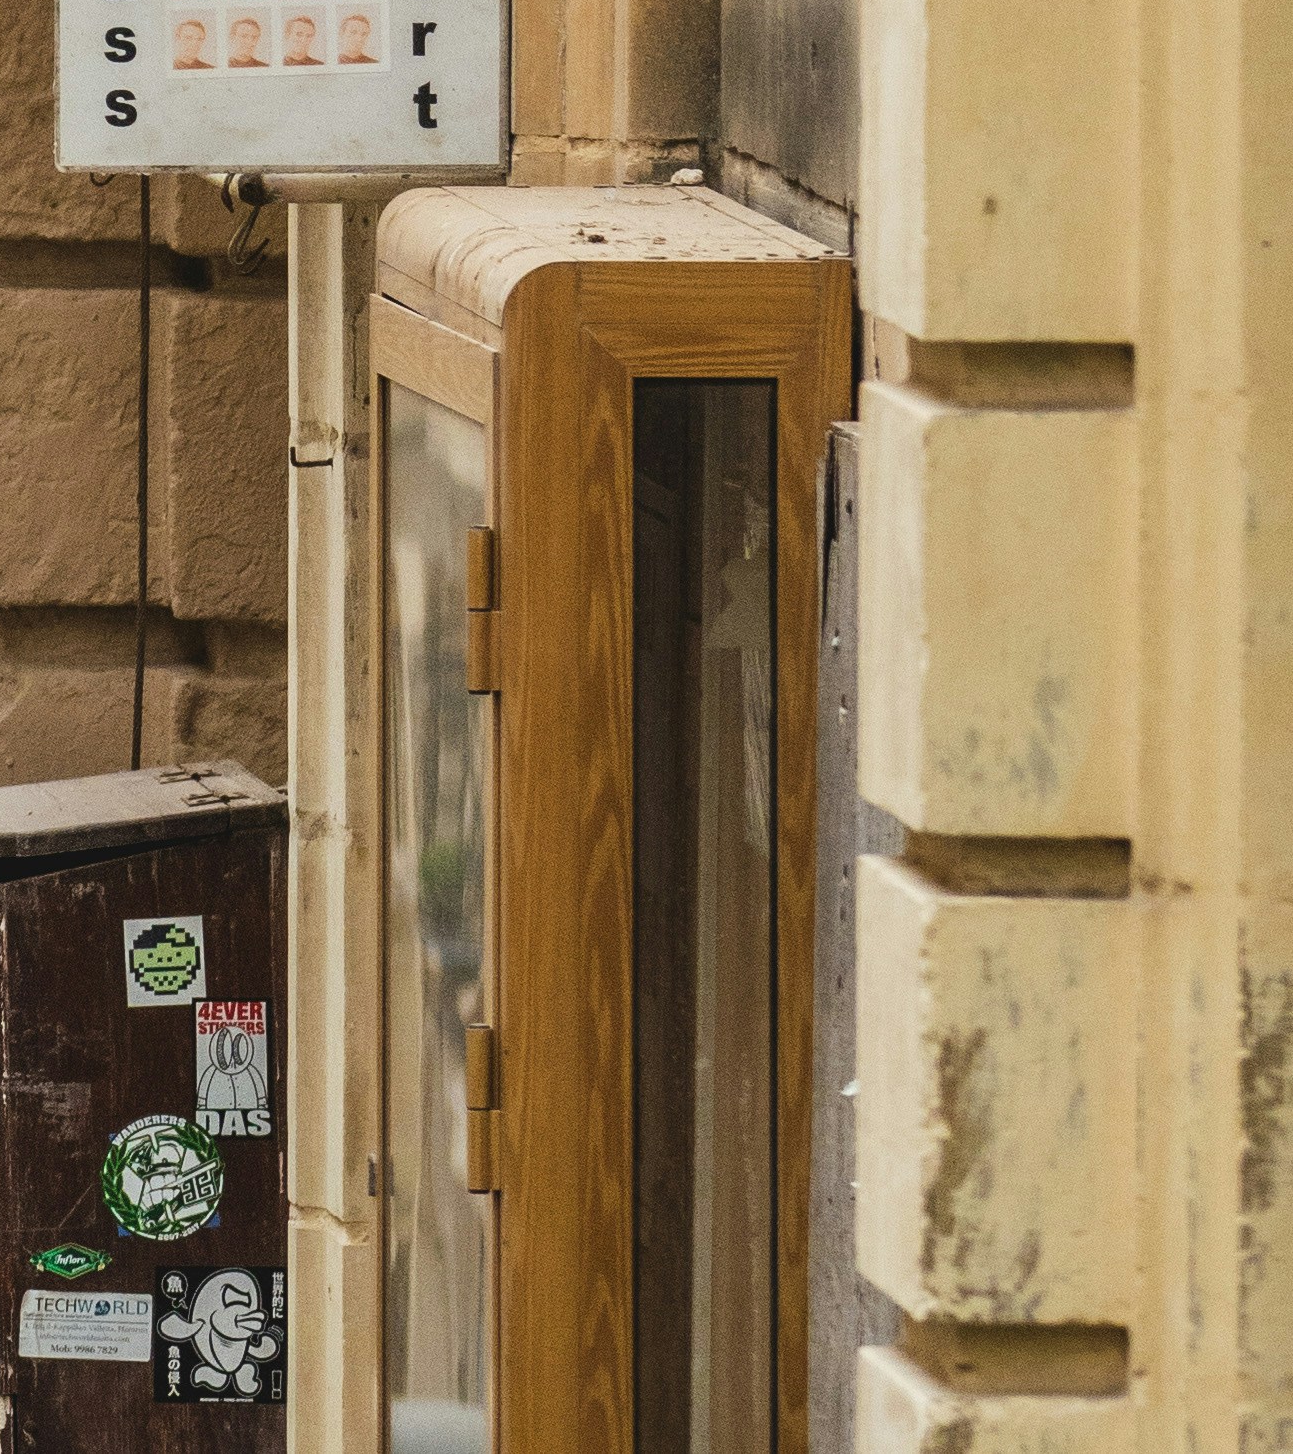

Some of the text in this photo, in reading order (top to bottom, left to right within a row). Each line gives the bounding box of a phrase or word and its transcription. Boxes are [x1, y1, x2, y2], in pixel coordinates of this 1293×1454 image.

[198, 1002, 264, 1021] 4EVER
[112, 1114, 187, 1146] WANDERERS
[195, 1109, 272, 1137] DAS
